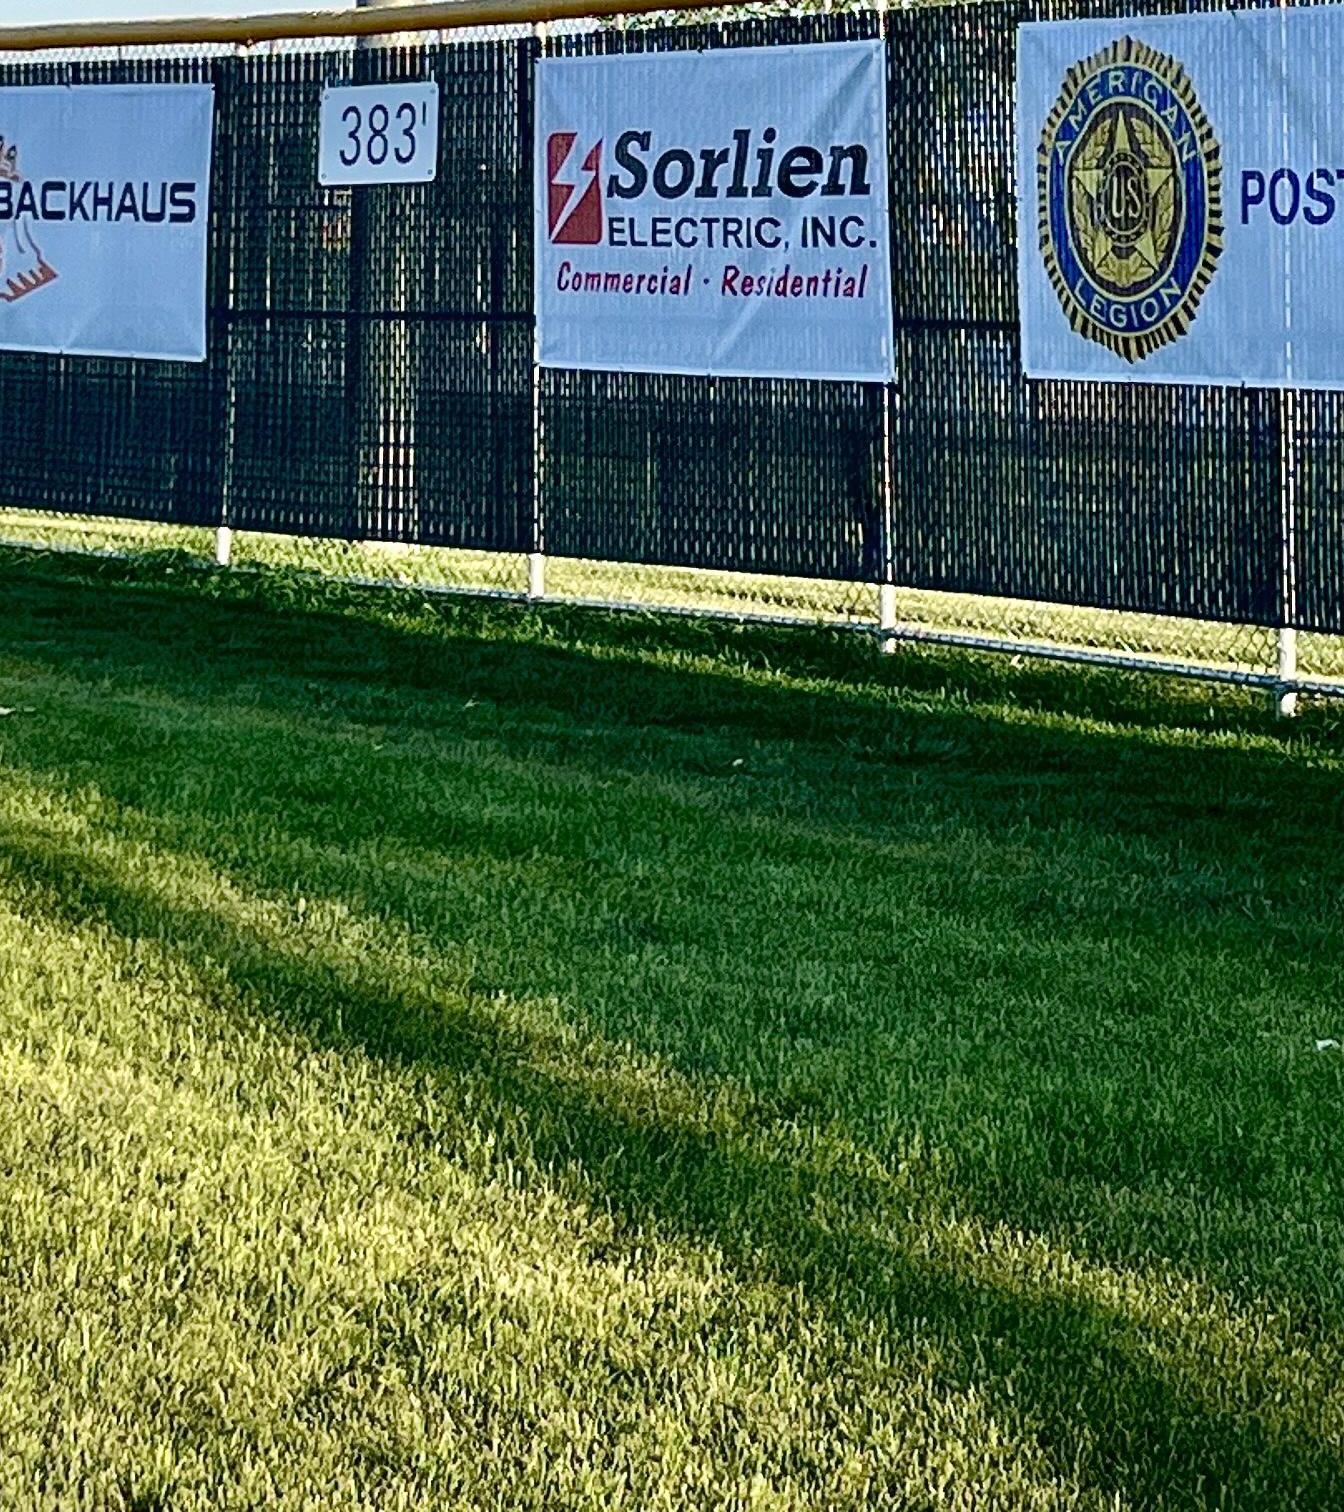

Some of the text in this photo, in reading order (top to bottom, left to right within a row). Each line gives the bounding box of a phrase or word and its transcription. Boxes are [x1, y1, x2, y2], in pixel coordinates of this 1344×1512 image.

[1056, 70, 1197, 167] AMERICAN
[606, 127, 871, 199] Sorlien
[1111, 175, 1143, 218] US
[608, 216, 877, 253] ELECTRIC, INC.
[556, 261, 869, 298] Commercial Residential
[1074, 277, 1182, 328] LEGION
